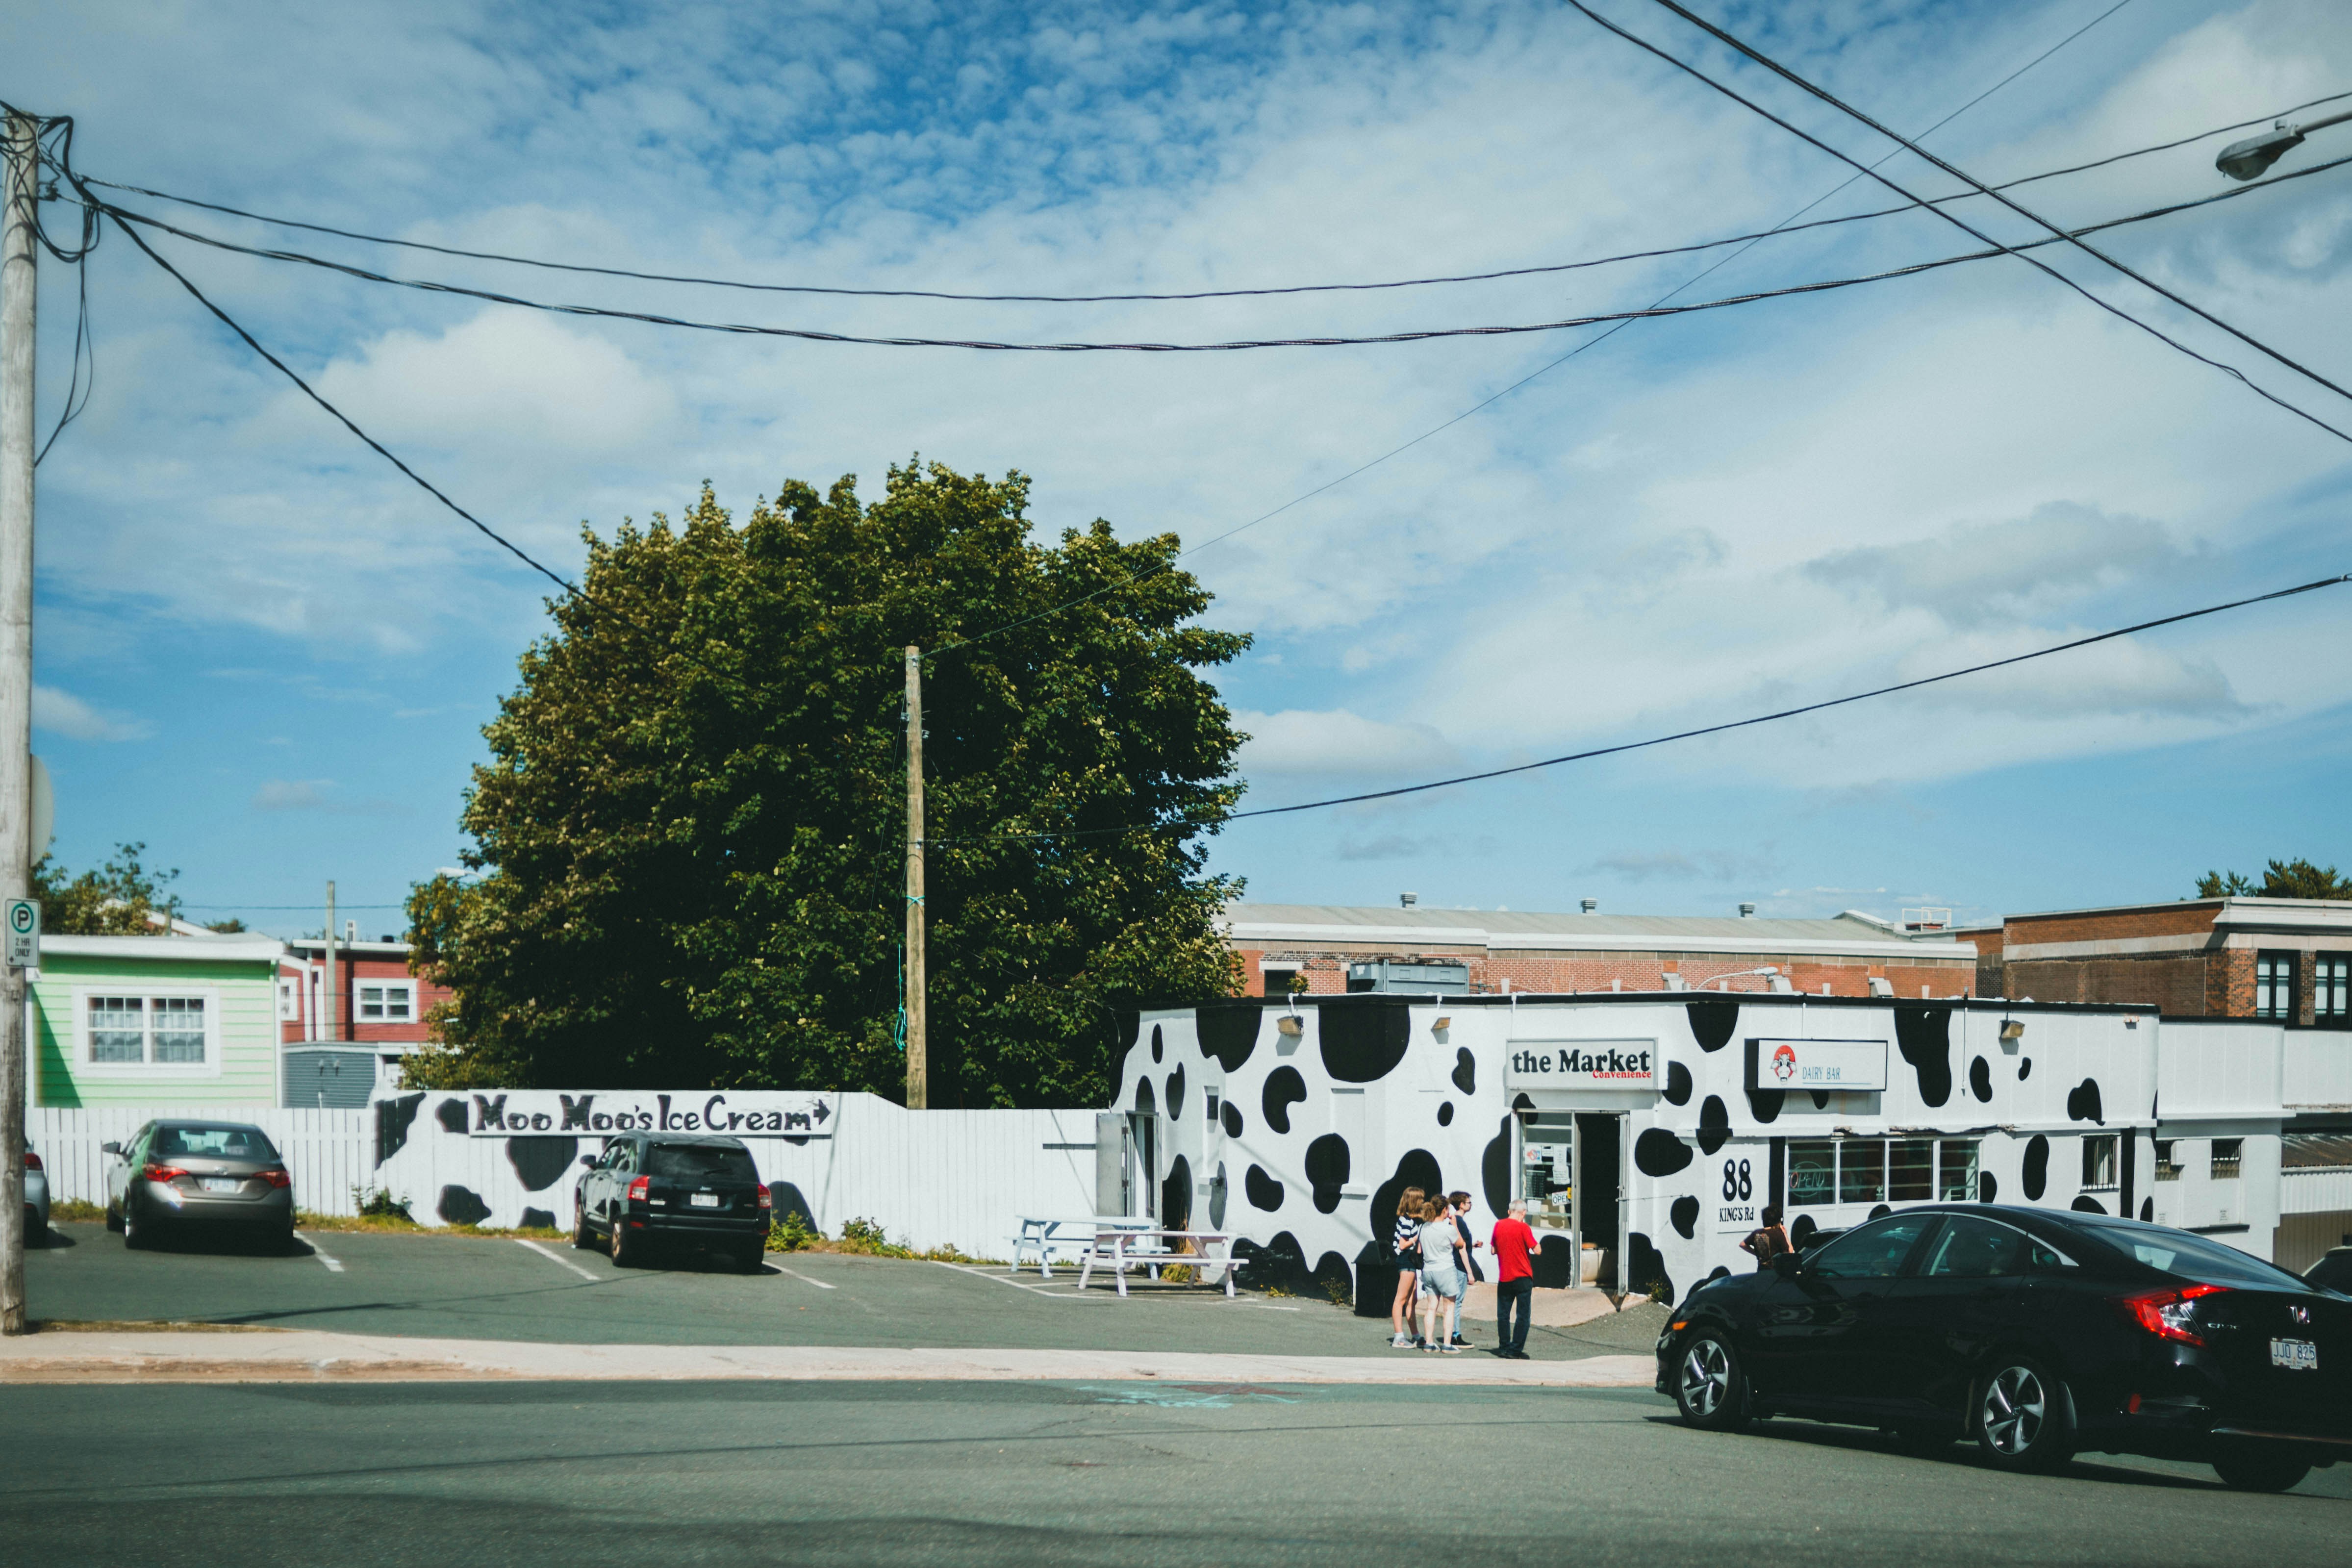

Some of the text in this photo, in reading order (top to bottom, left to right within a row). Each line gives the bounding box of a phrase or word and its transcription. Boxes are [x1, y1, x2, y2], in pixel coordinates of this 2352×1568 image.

[18, 910, 29, 927] P
[15, 937, 30, 946] 2 HR
[15, 948, 30, 957] ONLY
[1512, 1048, 1650, 1073] the Market
[1593, 1069, 1651, 1079] Convenience
[1802, 1066, 1840, 1080] DAIRY BAR
[473, 1094, 811, 1131] Moo Moo's Ice Cream
[1722, 1159, 1752, 1202] 88
[1790, 1171, 1821, 1189] OPEN
[1719, 1207, 1754, 1222] KING'S Rd
[2297, 1345, 2315, 1361] 825
